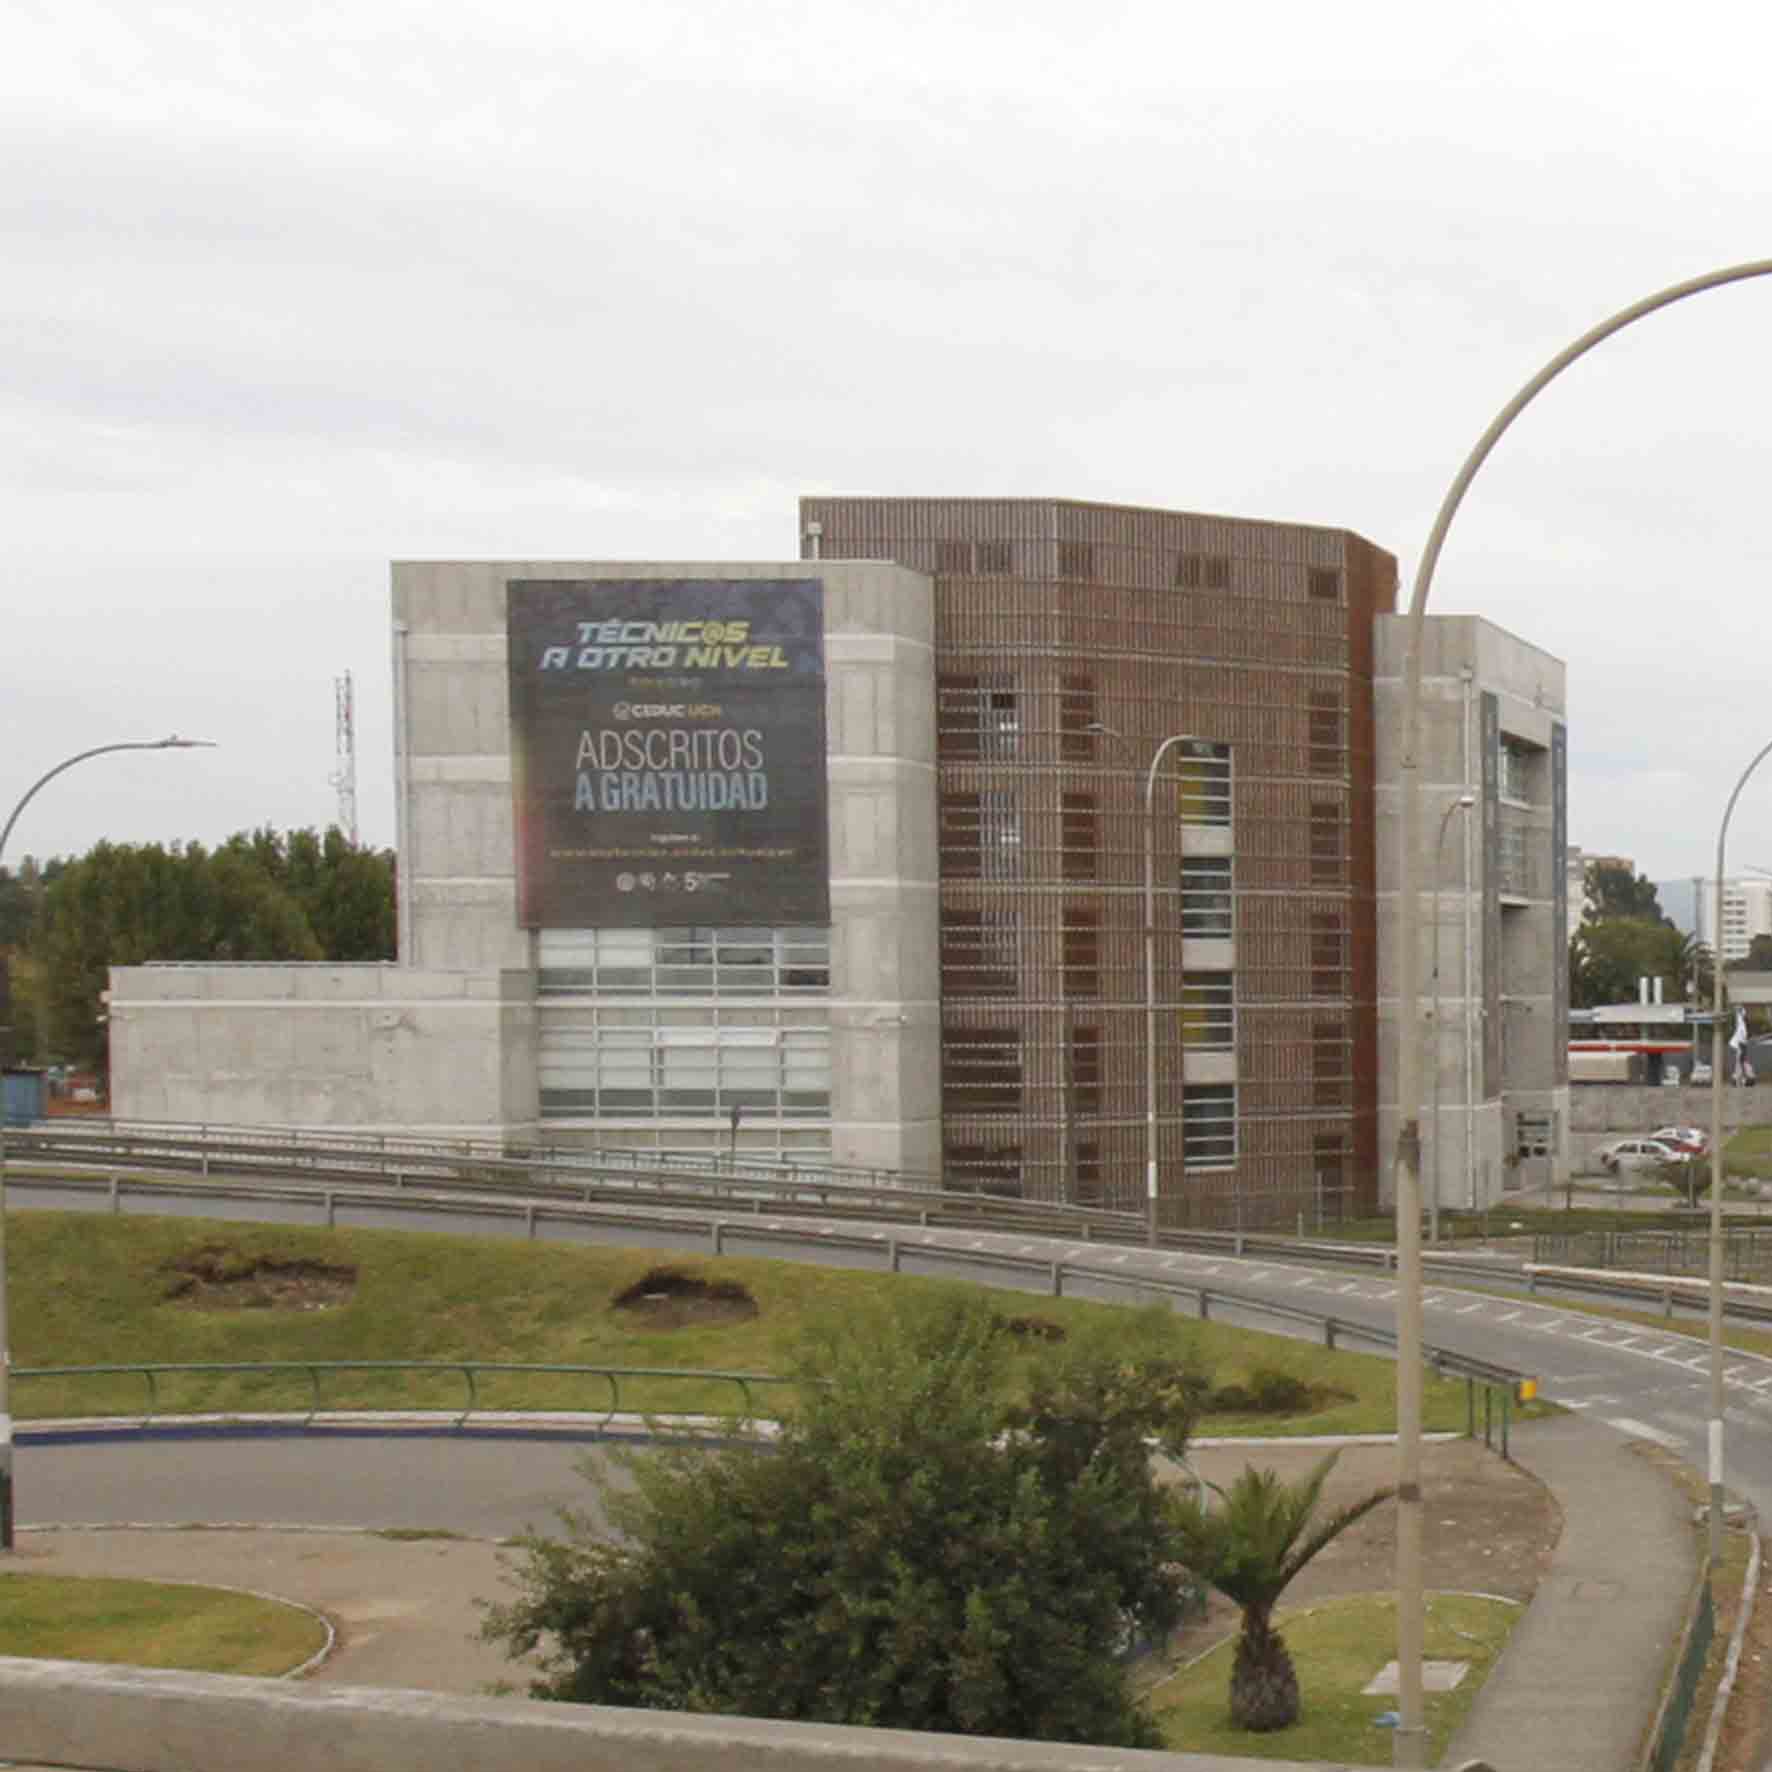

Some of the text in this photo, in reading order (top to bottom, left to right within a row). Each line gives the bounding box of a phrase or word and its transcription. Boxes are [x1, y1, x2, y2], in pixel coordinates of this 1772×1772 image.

[541, 646, 788, 668] A OTRO NIVEL
[576, 729, 763, 770] ADSCRITOS
[575, 772, 768, 811] A GRATUIDAD
